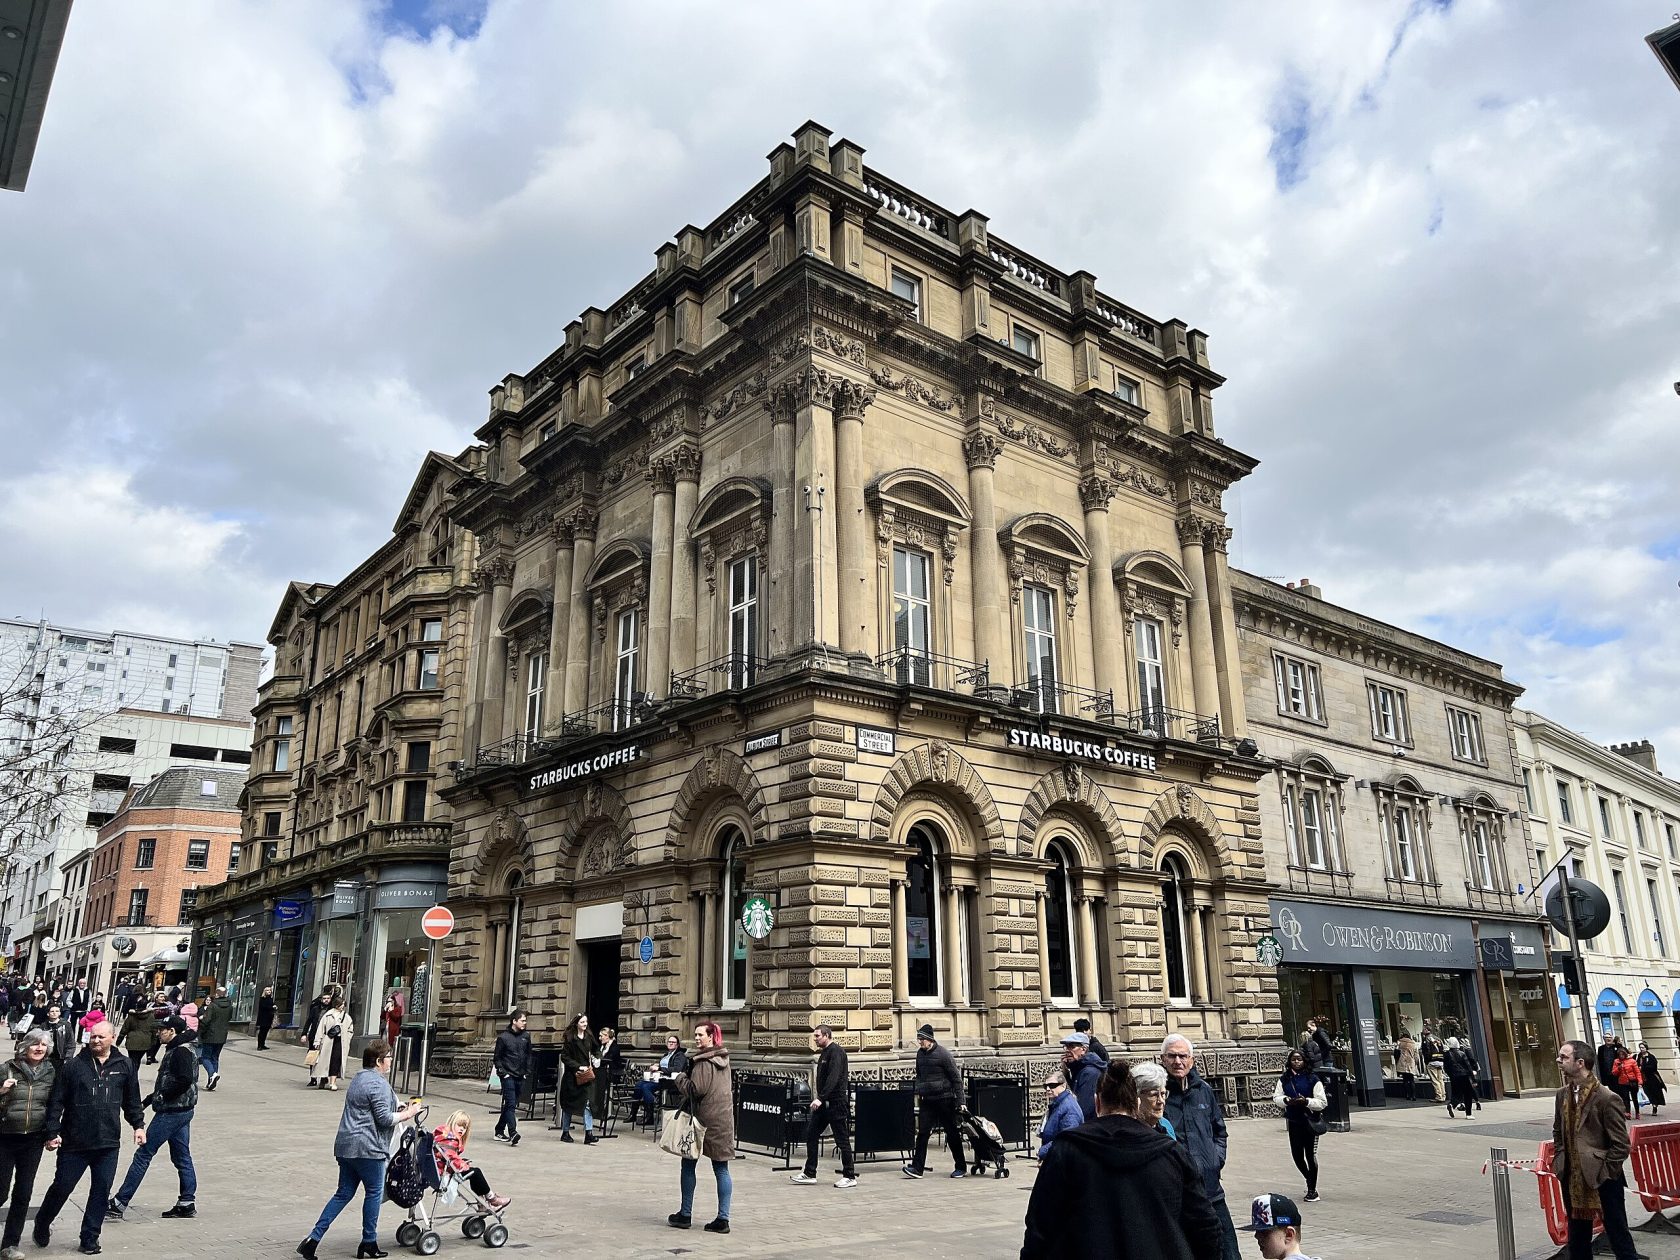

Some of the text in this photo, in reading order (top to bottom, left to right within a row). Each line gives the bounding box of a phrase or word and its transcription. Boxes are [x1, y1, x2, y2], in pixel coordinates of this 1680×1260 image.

[859, 729, 892, 742] COMMERCIAL
[863, 739, 888, 751] STREET
[1010, 728, 1156, 771] STARBUCKS COFFEE
[530, 745, 636, 790] STARBUCKS COFFEE
[742, 1101, 781, 1114] STARBUCKS
